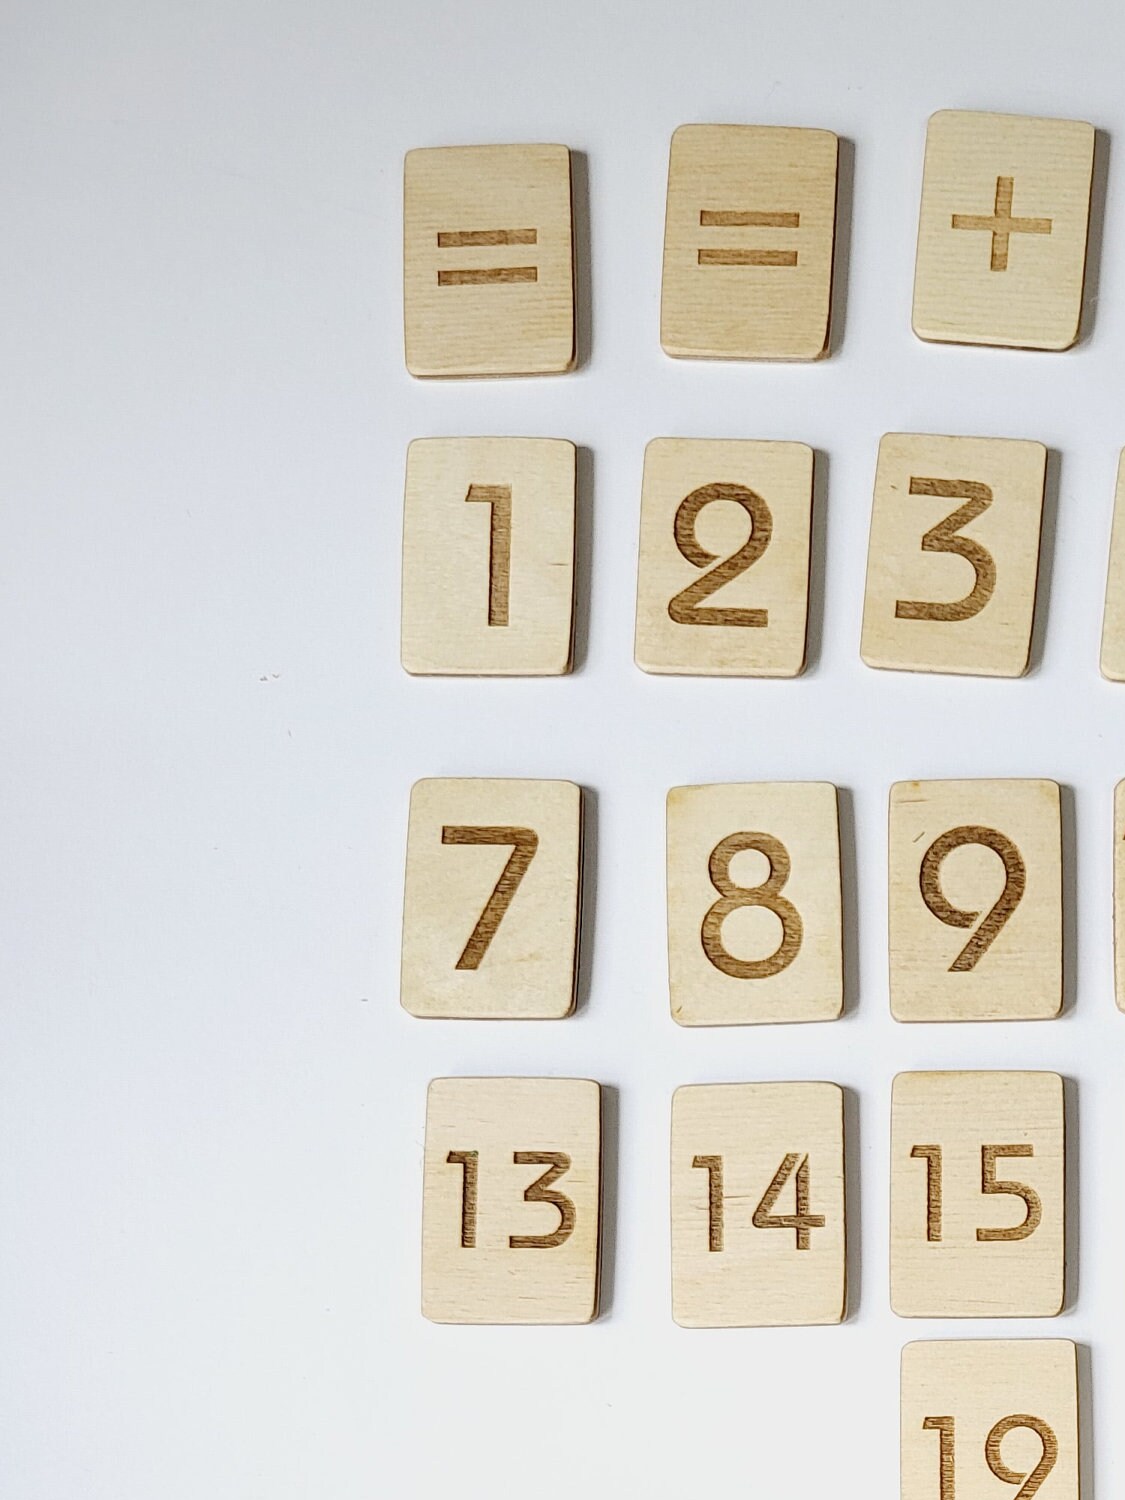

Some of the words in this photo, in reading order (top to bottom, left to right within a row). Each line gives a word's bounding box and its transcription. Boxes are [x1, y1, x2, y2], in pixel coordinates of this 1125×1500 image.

[436, 228, 538, 286] =
[697, 209, 800, 267] =
[951, 175, 1052, 272] +
[465, 483, 511, 626] 1
[667, 482, 772, 627] 2
[894, 476, 996, 622] 3
[441, 826, 538, 970] 7
[700, 831, 802, 980] 8
[919, 826, 1025, 972] 9
[446, 1151, 575, 1249] 13
[692, 1153, 825, 1252] 14
[910, 1144, 1041, 1242] 15
